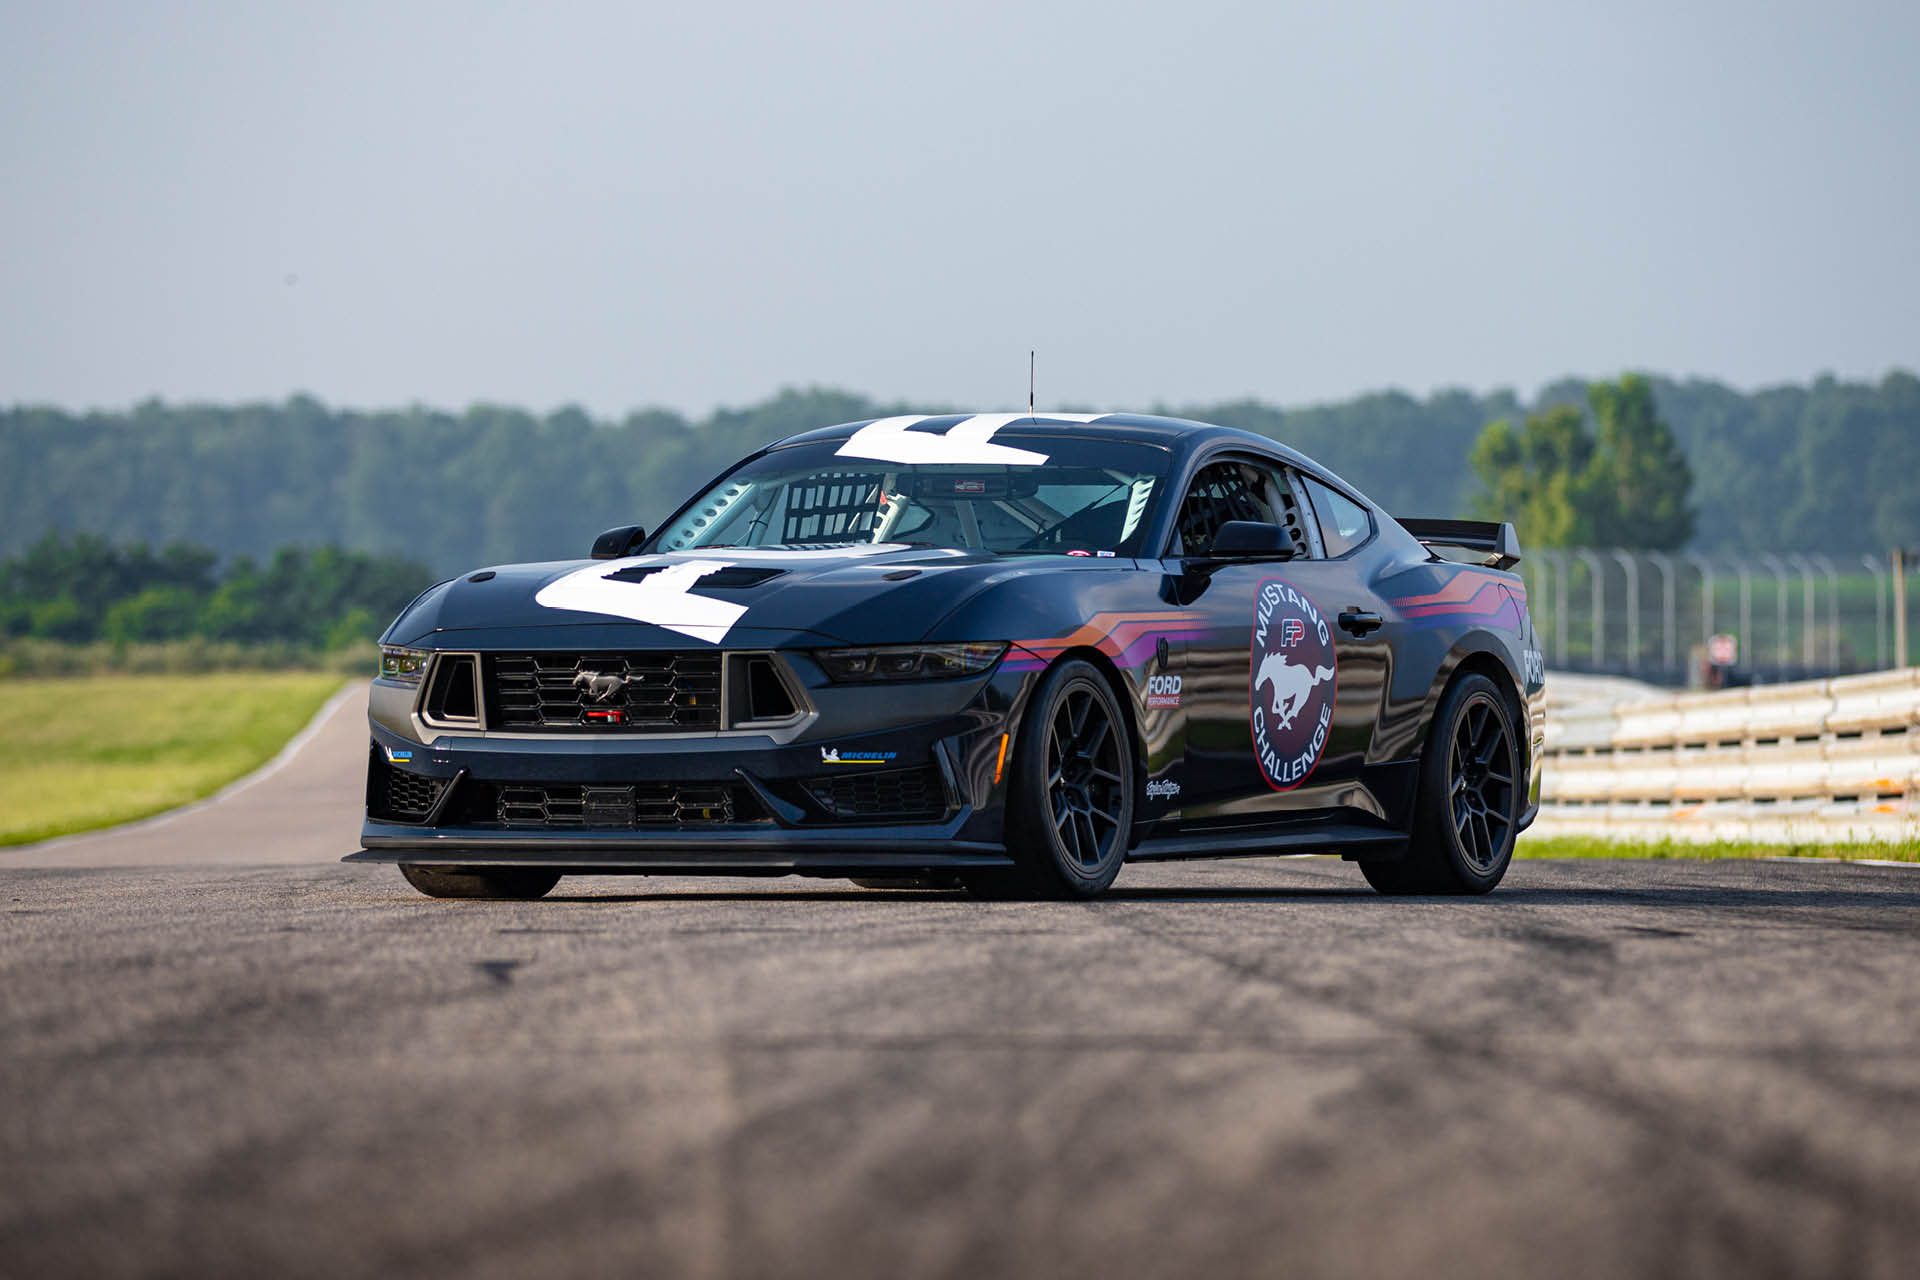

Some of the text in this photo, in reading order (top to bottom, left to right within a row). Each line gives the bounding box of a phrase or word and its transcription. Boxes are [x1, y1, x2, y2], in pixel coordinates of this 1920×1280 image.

[1256, 583, 1329, 648] MUSTANG
[1148, 675, 1182, 695] FORD
[840, 751, 897, 759] MICHELIN
[1254, 702, 1331, 782] CHALLENGE
